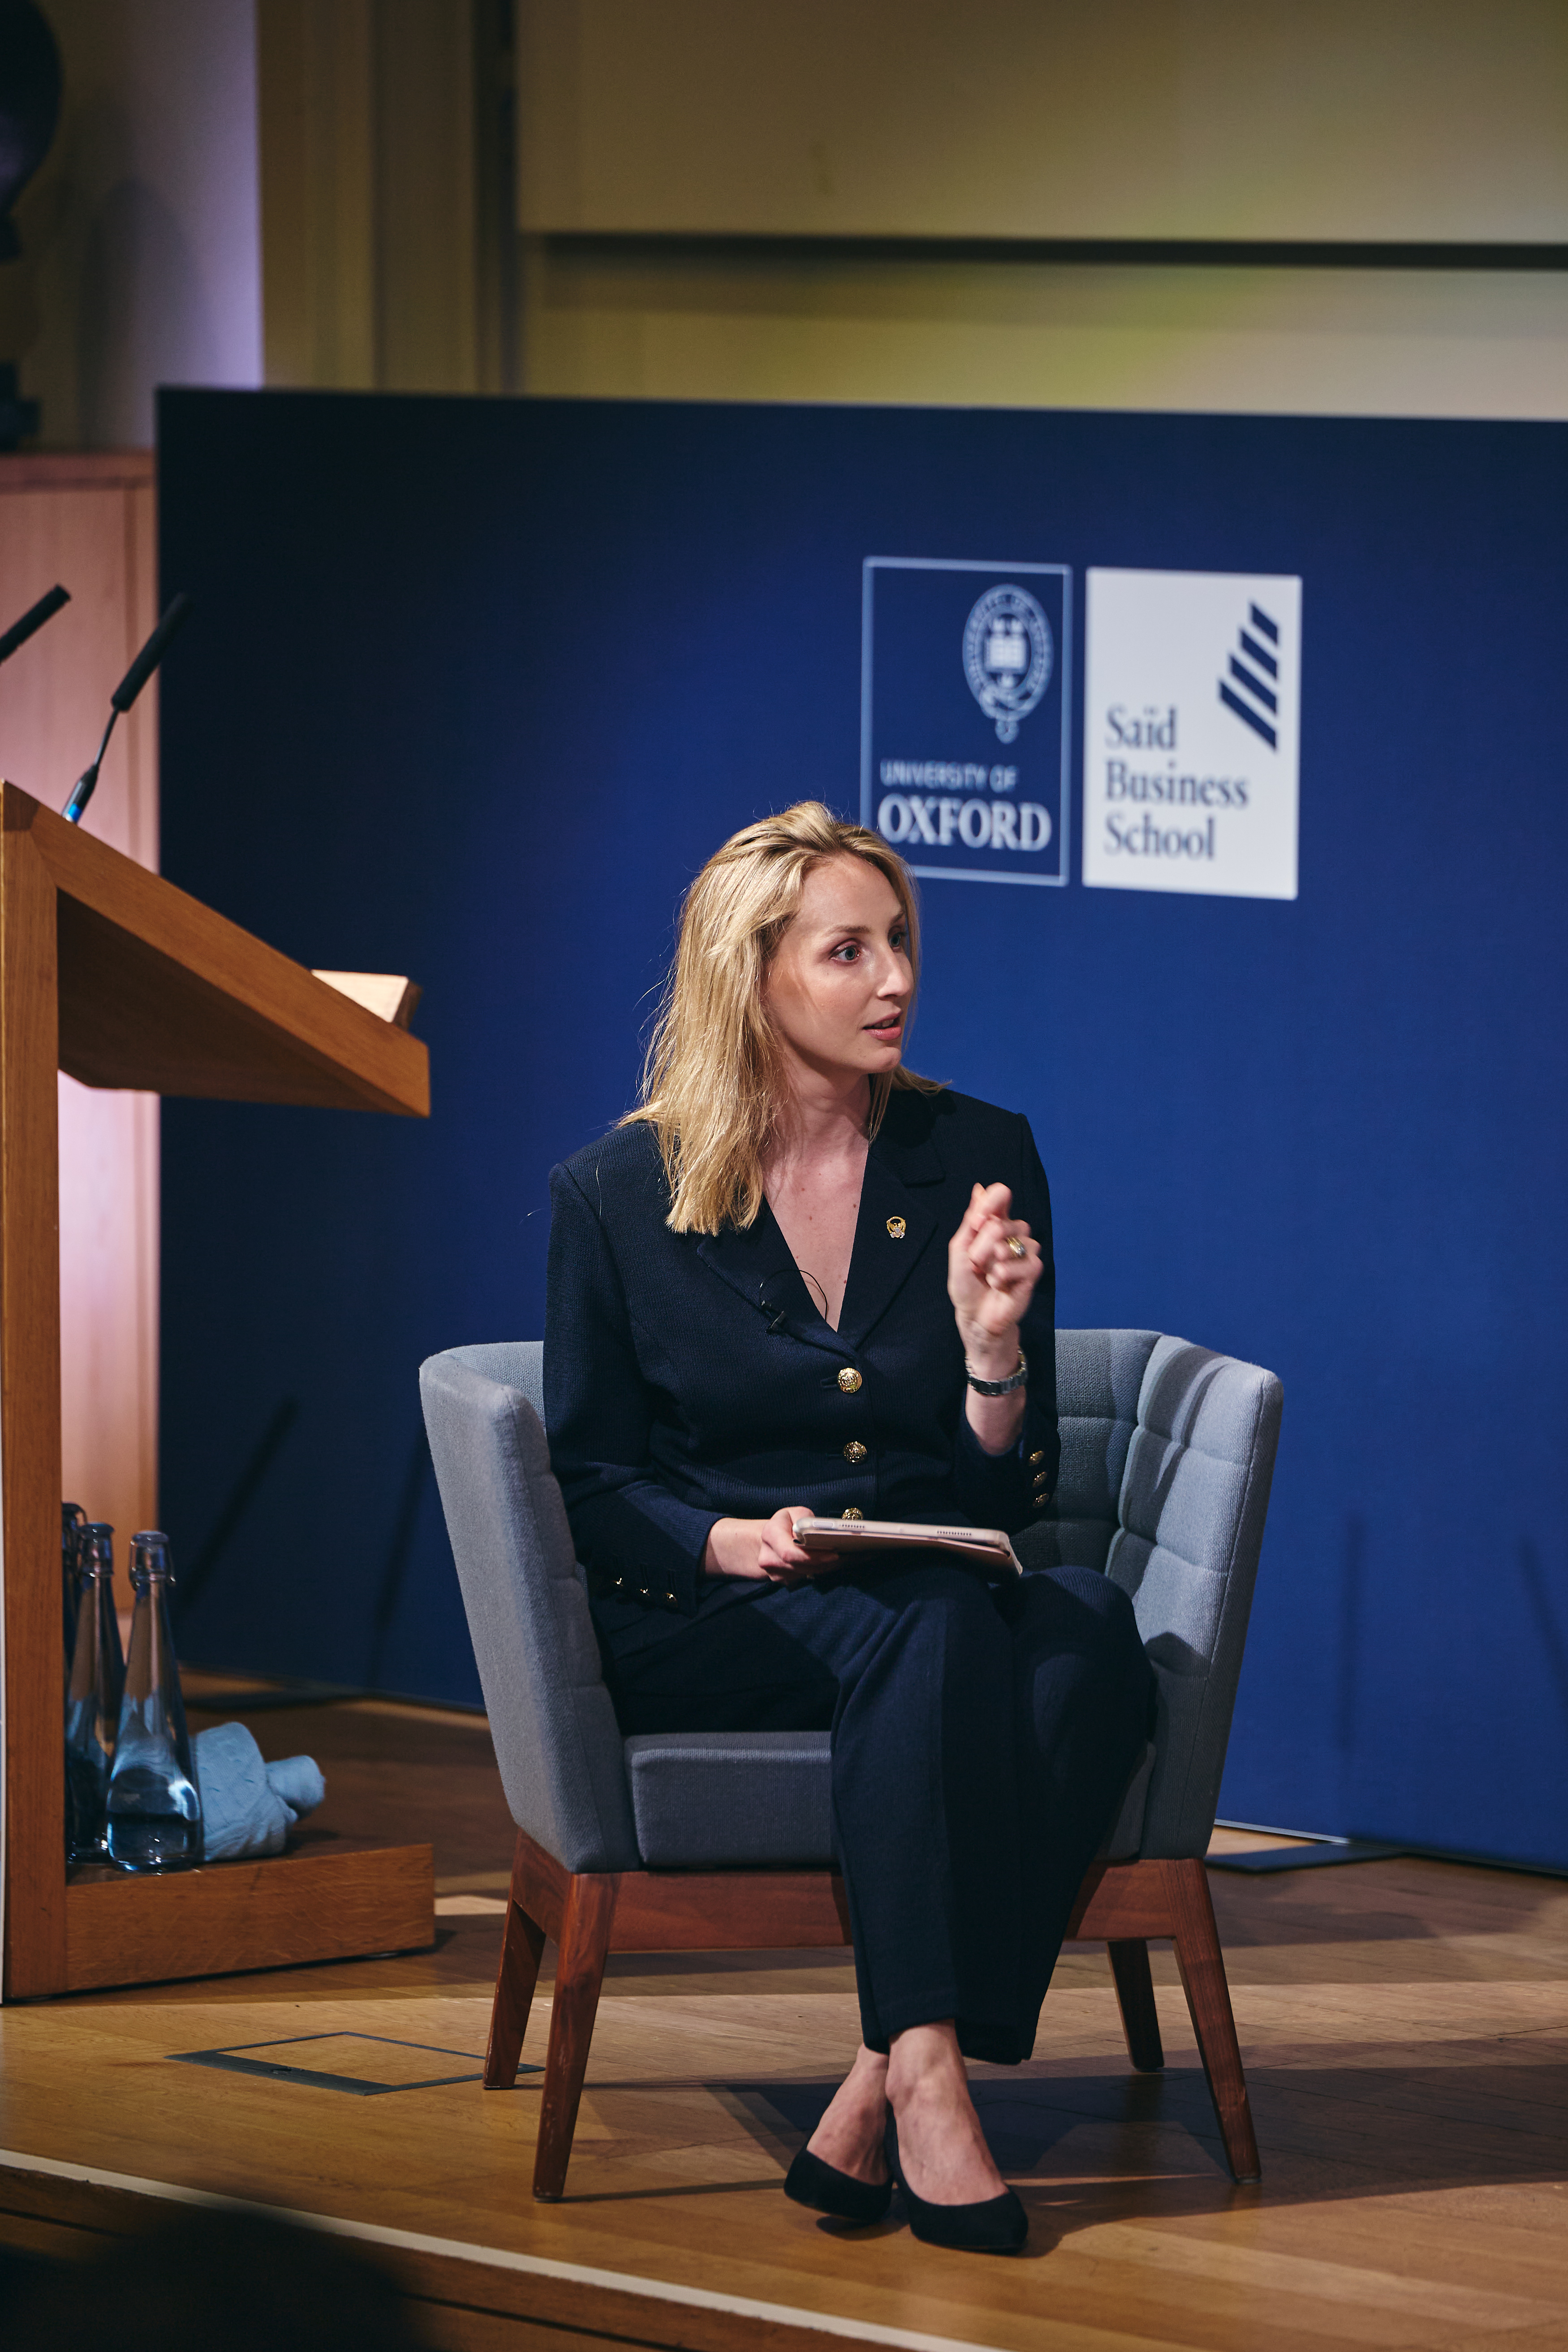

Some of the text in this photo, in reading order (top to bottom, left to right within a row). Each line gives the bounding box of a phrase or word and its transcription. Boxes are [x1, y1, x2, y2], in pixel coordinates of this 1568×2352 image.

[1106, 704, 1176, 750] Saïd
[880, 759, 1018, 793] UNIVERSITY OF
[1106, 759, 1249, 809] Business
[878, 793, 1052, 851] OXFORD
[1105, 811, 1215, 861] School
